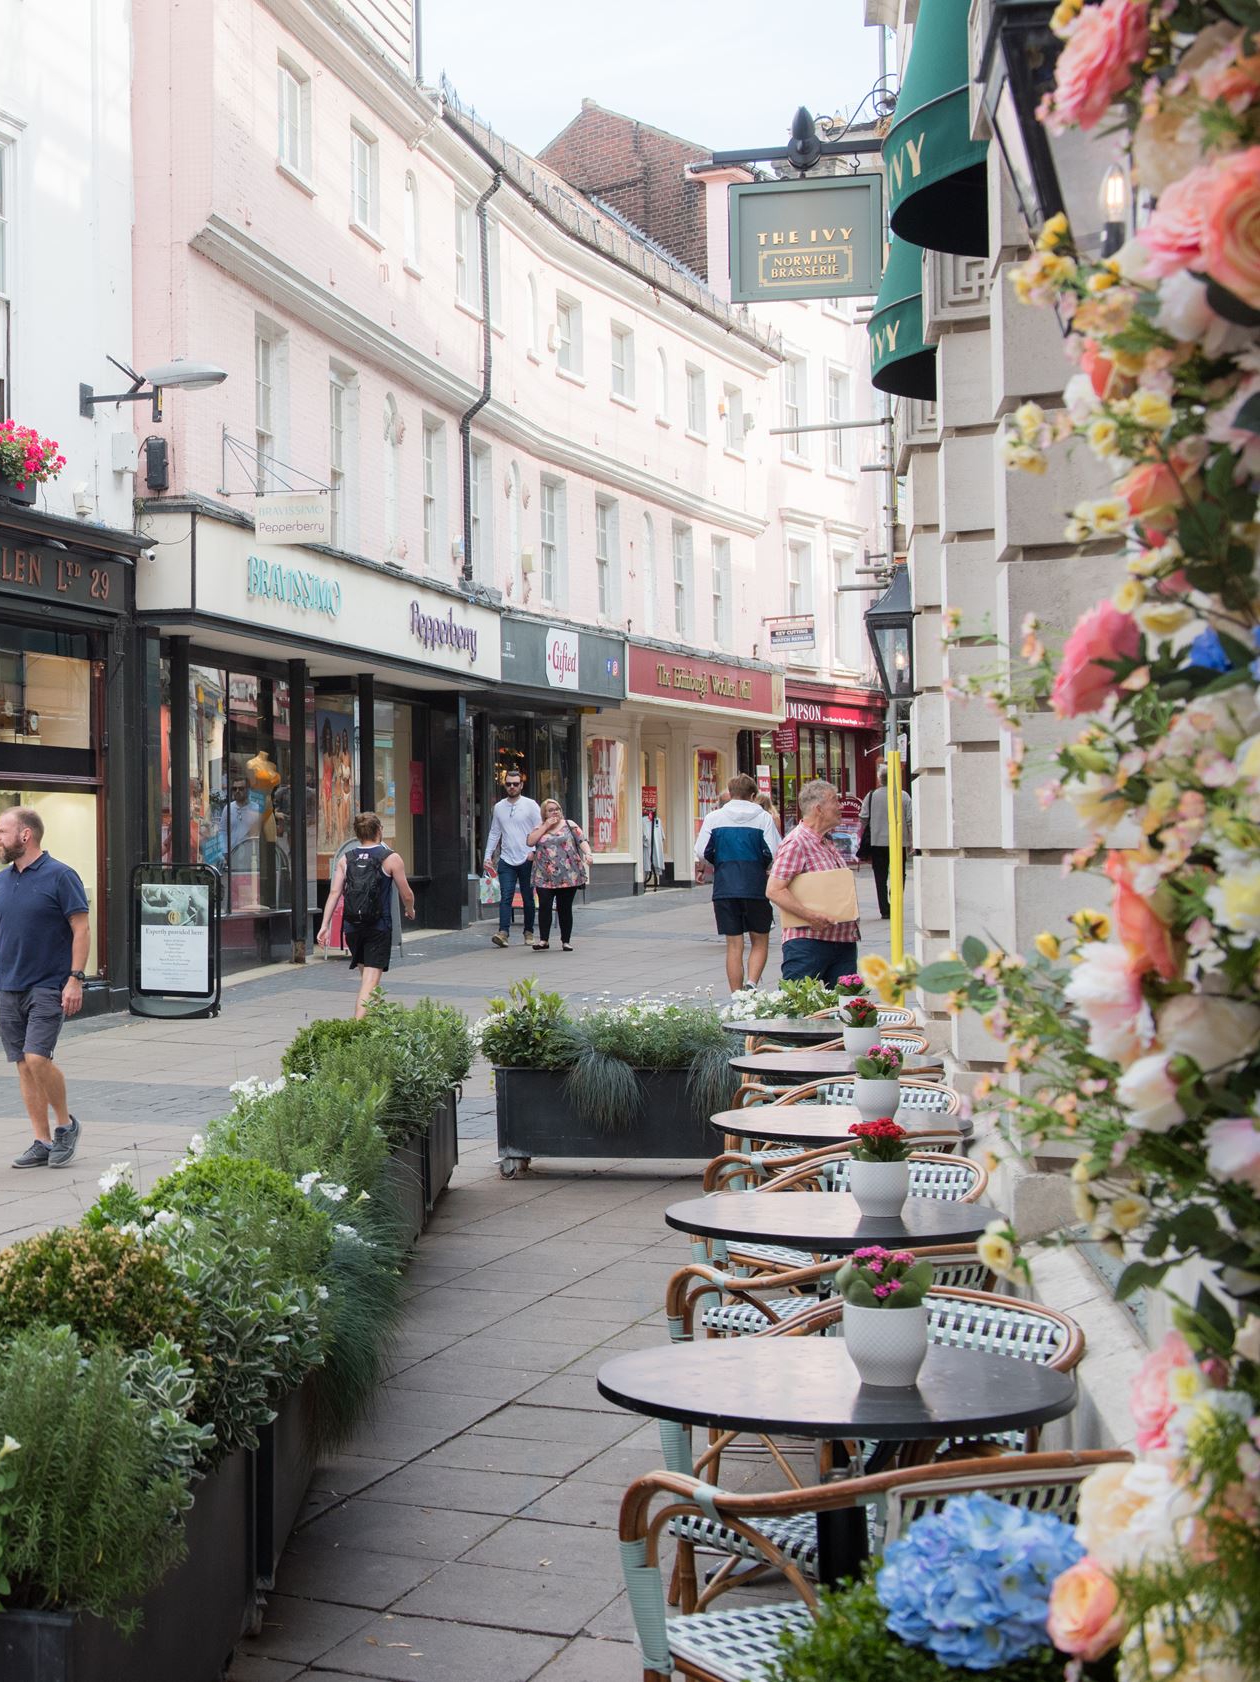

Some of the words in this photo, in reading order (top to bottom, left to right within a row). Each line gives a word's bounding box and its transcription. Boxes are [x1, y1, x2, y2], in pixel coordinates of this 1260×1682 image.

[757, 231, 799, 245] THE
[810, 227, 853, 241] IVY
[774, 254, 836, 267] NORWICH
[771, 265, 839, 279] BRASSERIE
[258, 504, 324, 516] BRAVISSIMO
[259, 520, 325, 533] Pepperberry
[91, 569, 110, 600] 29
[248, 556, 341, 616] BRAVISSIMO
[410, 600, 478, 662] Pepperberry
[552, 641, 577, 683] Gifted
[657, 664, 670, 687] The
[673, 667, 708, 698] Edinburgh
[710, 674, 736, 697] Woollen
[738, 680, 752, 700] Mill
[785, 702, 821, 721] IMPSON
[697, 780, 717, 799] STOCK
[599, 821, 612, 842] GO!
[145, 928, 167, 937] Expertly
[167, 928, 190, 936] provided
